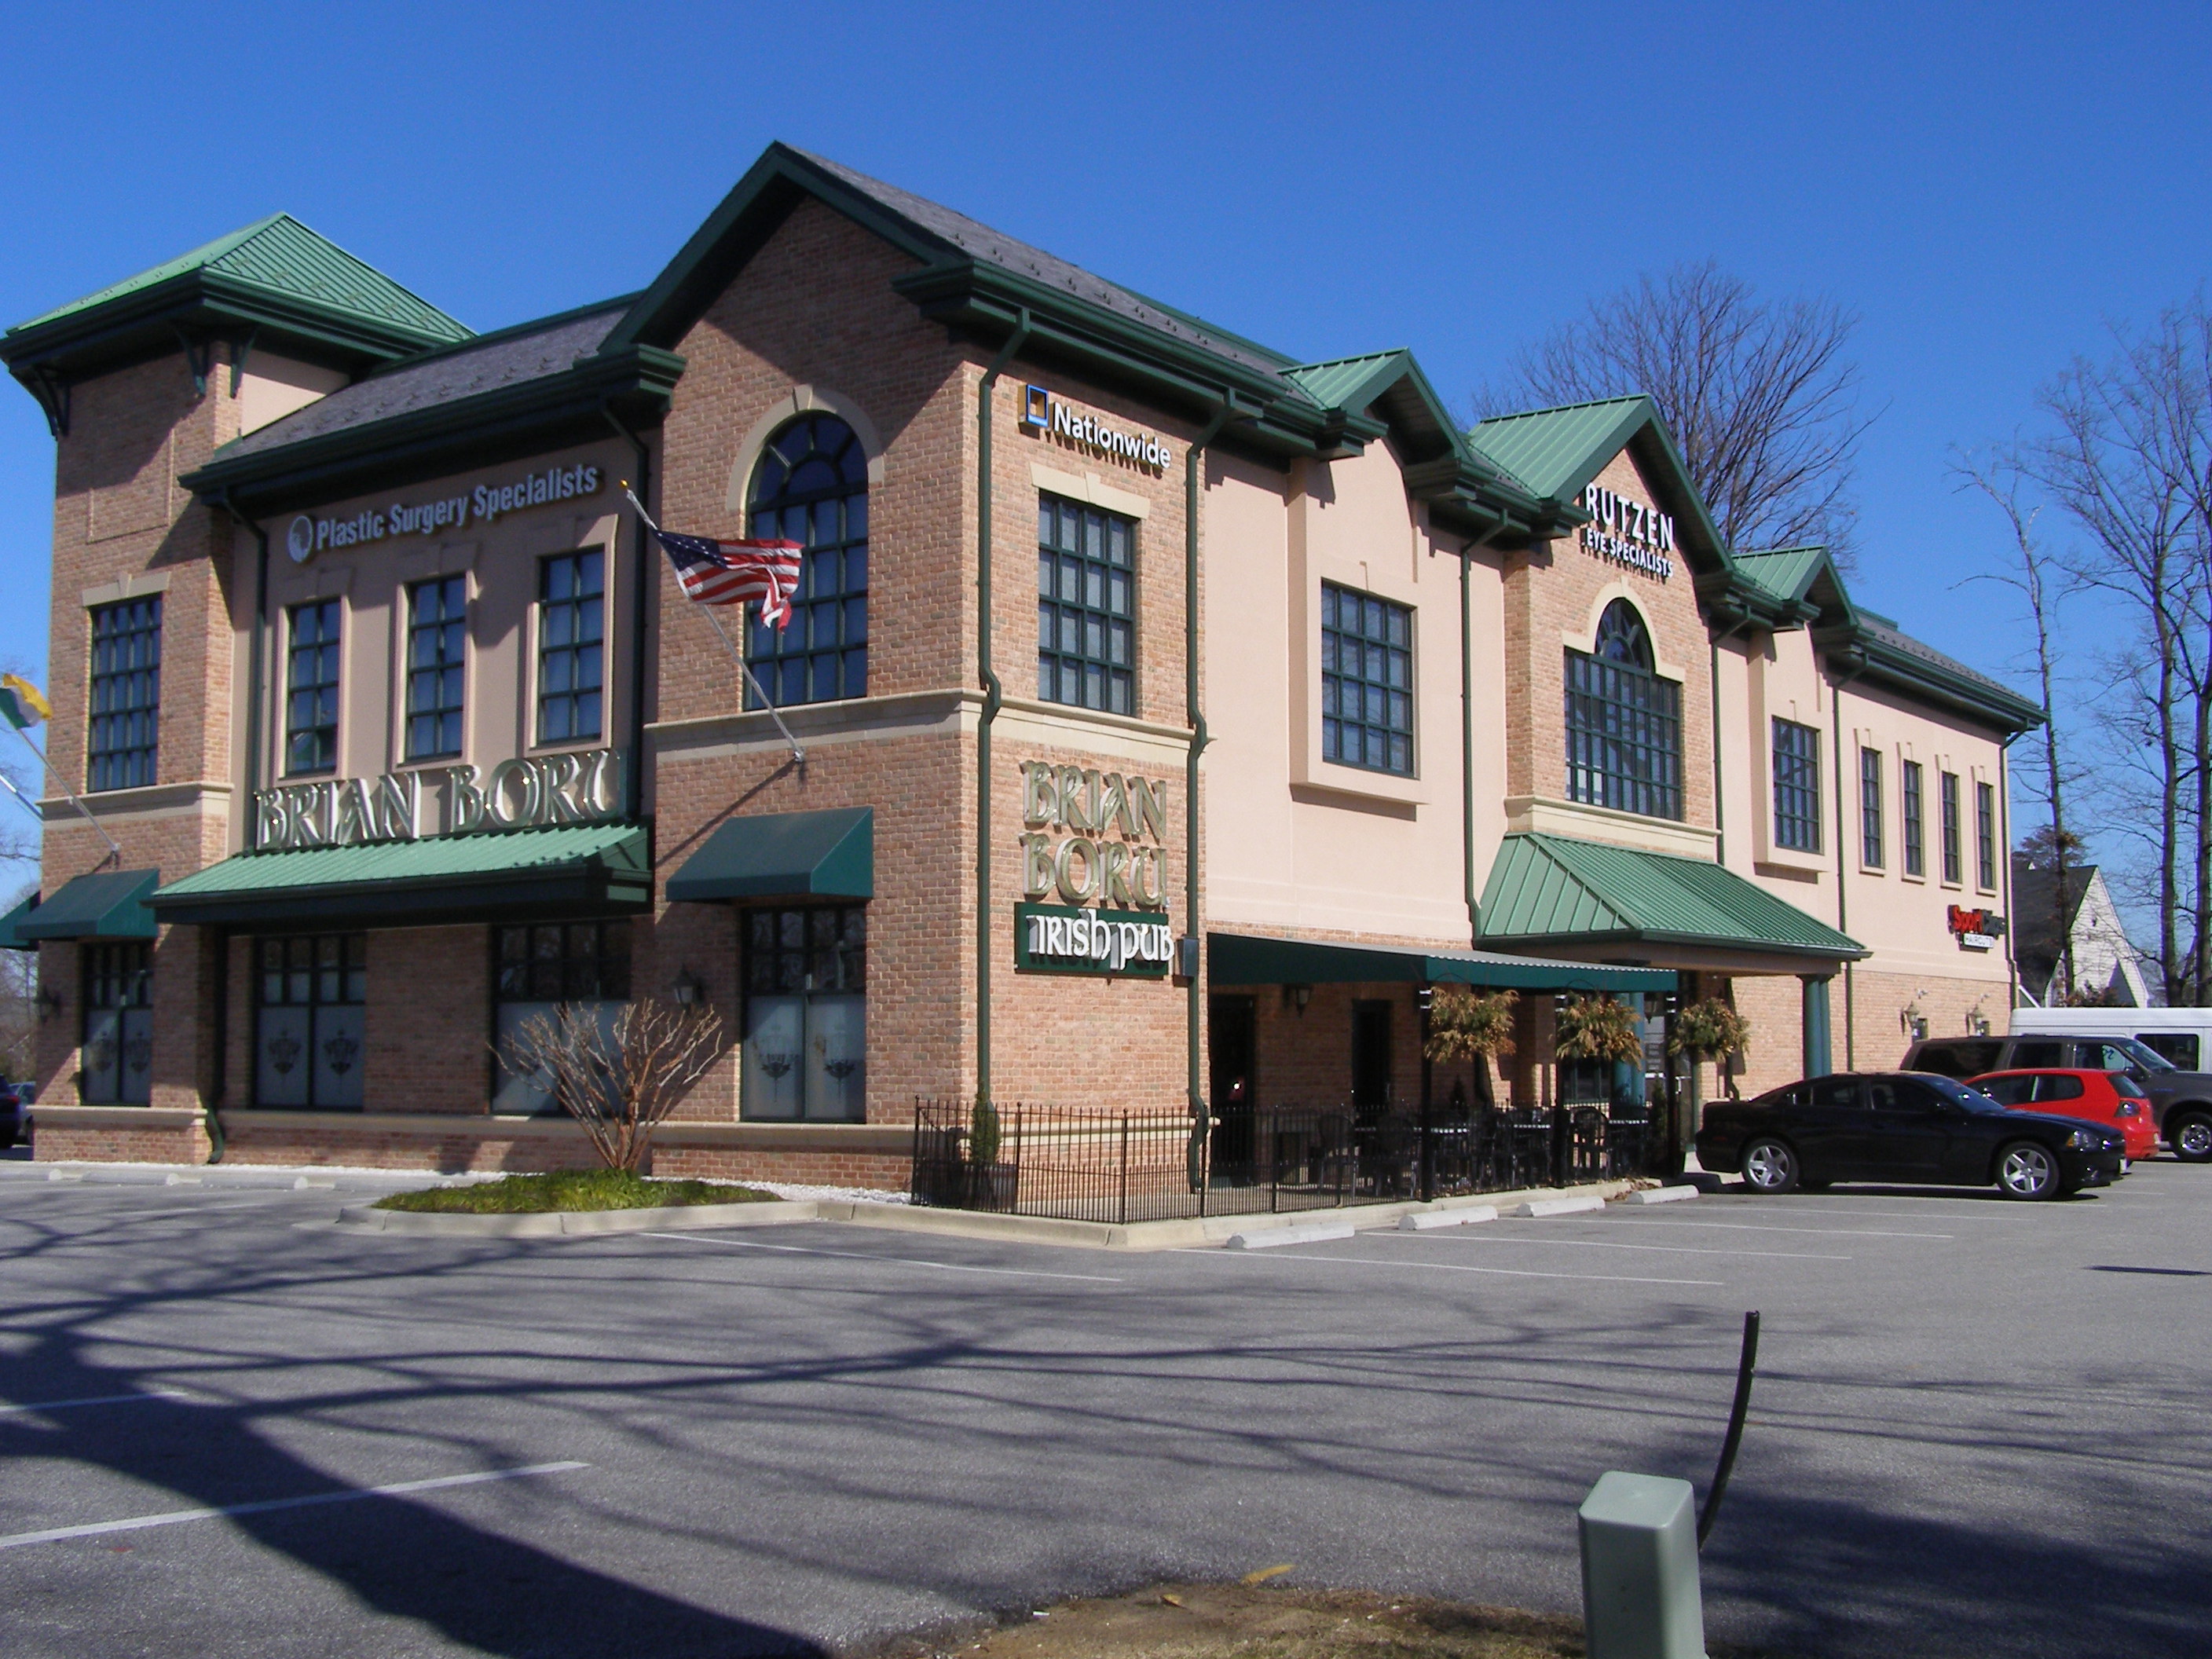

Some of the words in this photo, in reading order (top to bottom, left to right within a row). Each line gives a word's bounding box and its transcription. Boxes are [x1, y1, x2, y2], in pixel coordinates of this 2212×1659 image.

[1053, 401, 1171, 469] Nationwide
[317, 510, 385, 550] Plastic
[389, 495, 470, 536] Surgery
[473, 463, 599, 522] Specialists
[1585, 482, 1674, 551] RUTZEN
[1587, 527, 1608, 553] EYE
[1610, 537, 1674, 578] SPECIALISTS
[253, 770, 421, 850] BRIAN
[446, 749, 628, 834] BORU
[1020, 760, 1166, 840] BRIAN
[1019, 832, 1167, 906] BORU
